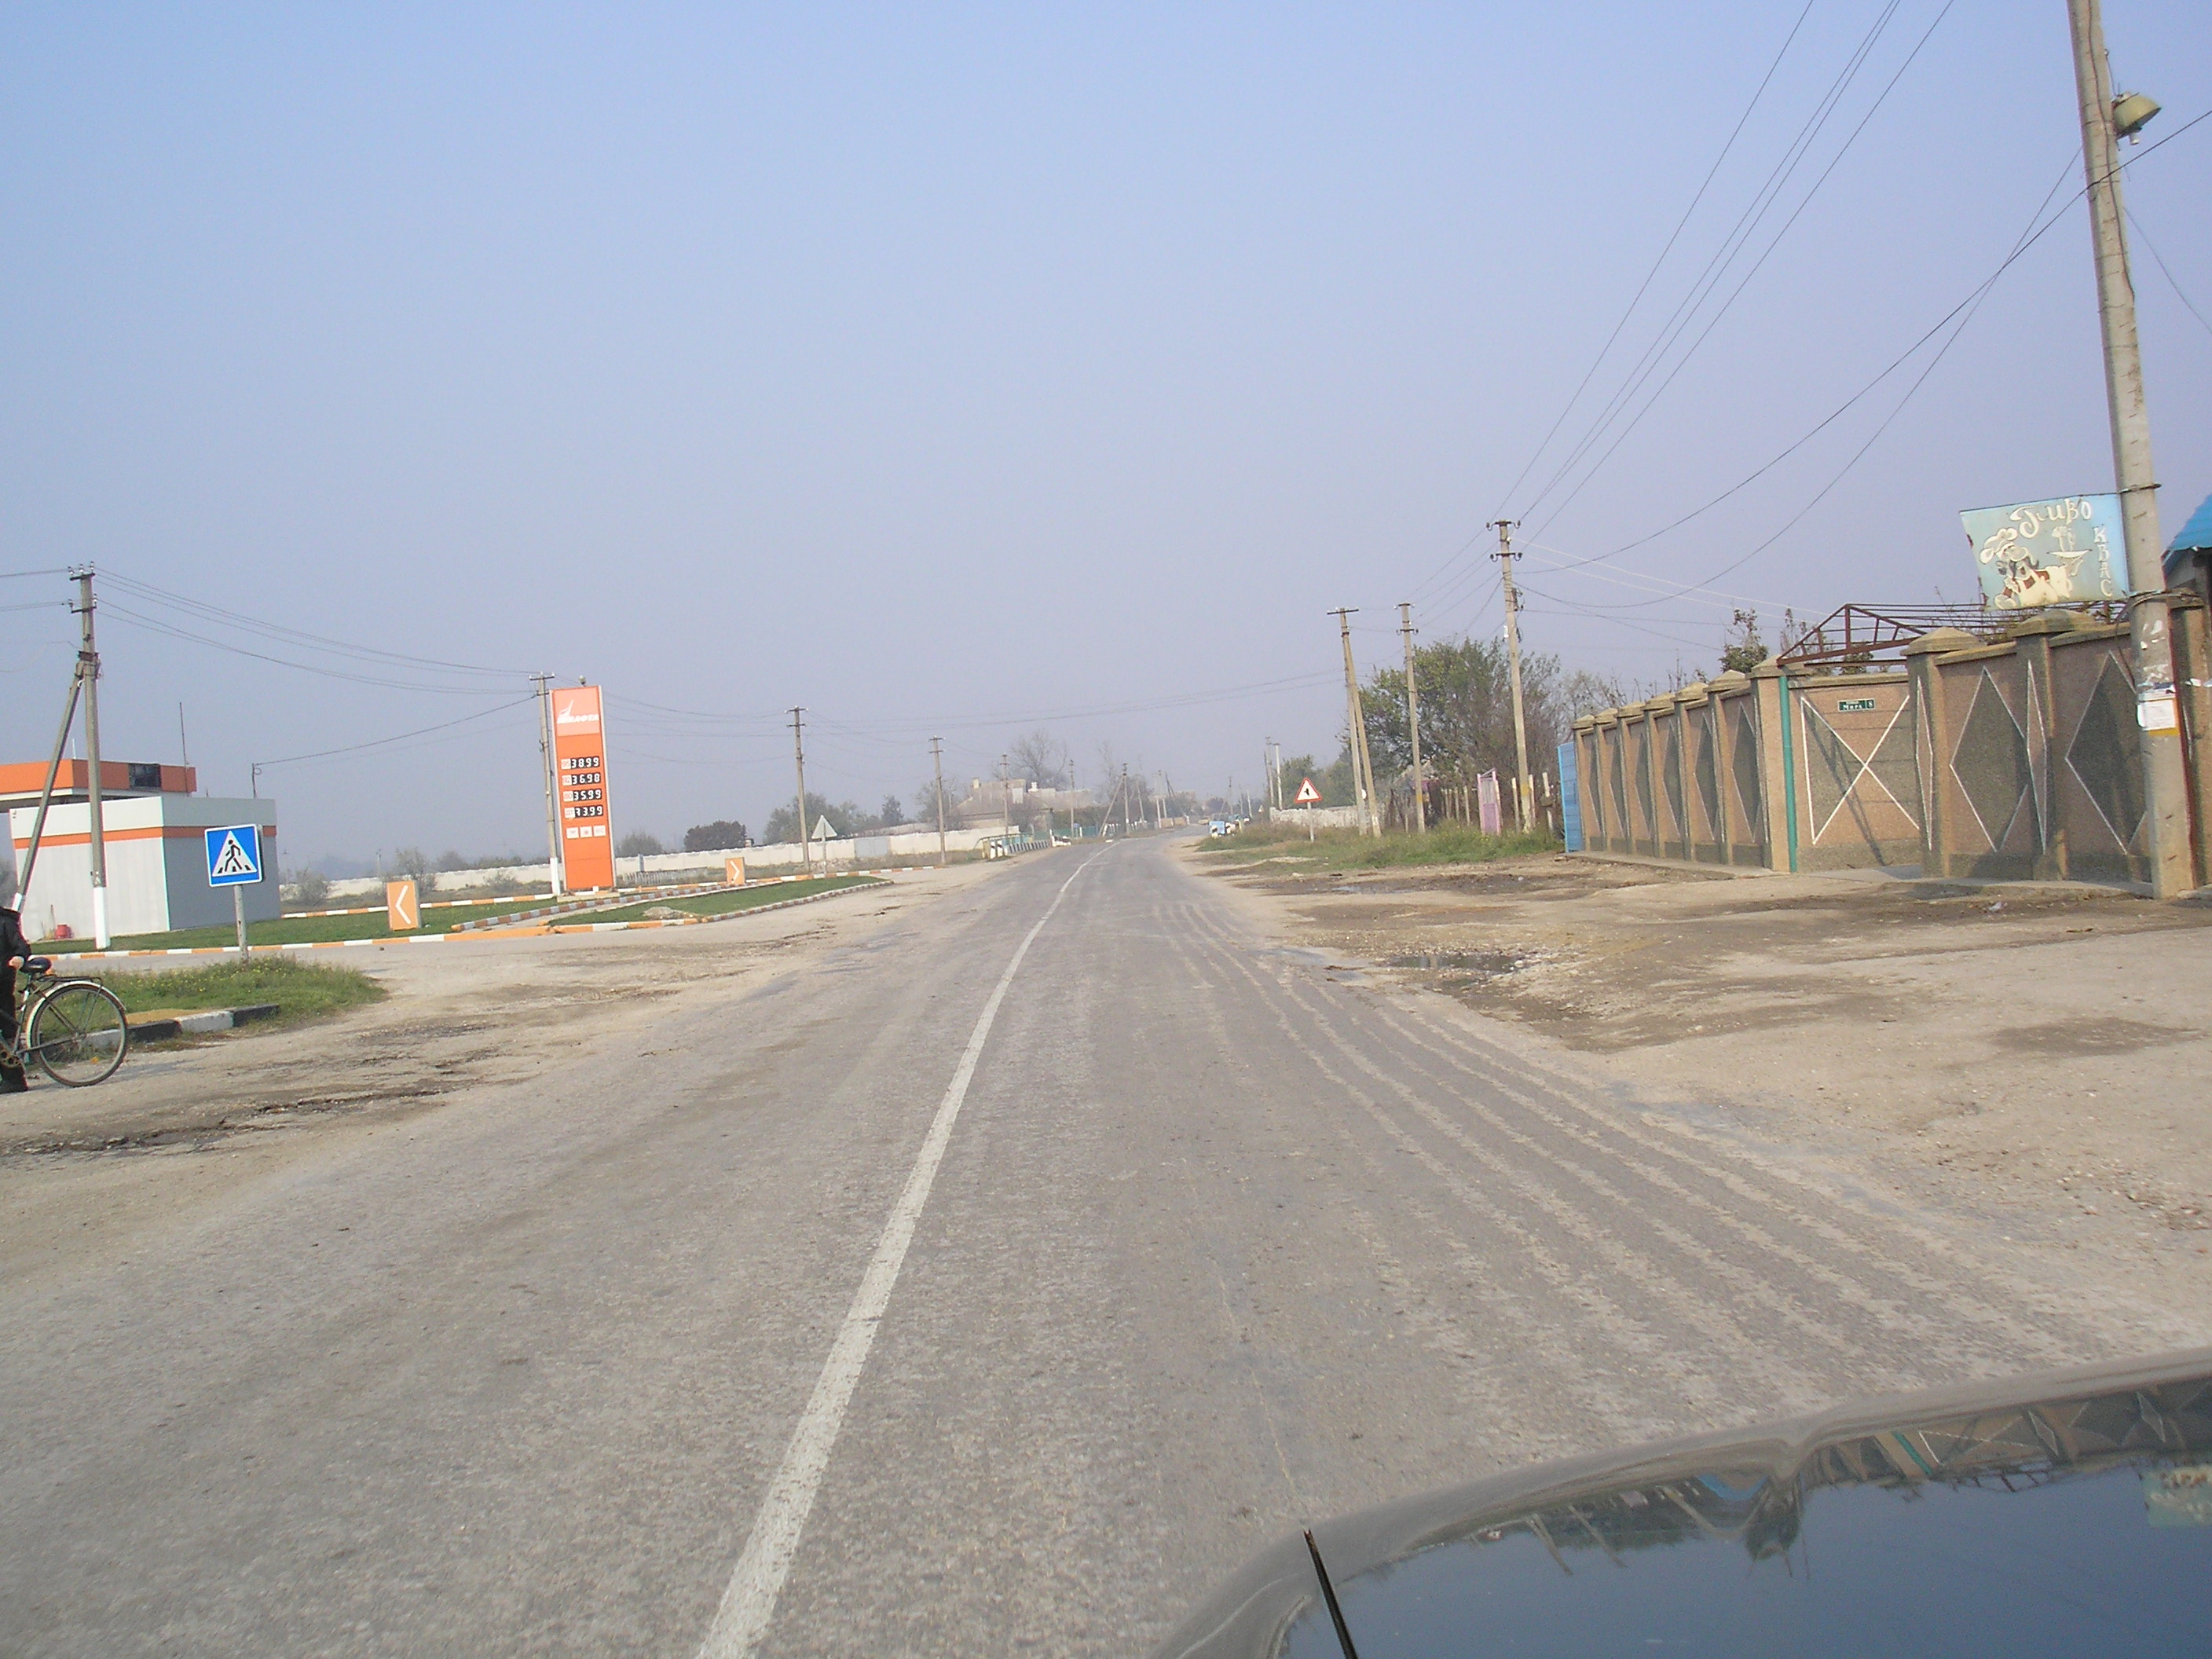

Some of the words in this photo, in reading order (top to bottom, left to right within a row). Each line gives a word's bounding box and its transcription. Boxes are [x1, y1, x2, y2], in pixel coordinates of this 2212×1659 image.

[571, 757, 599, 768] 38.99
[572, 773, 600, 785] 36.98
[573, 789, 602, 801] 35.99
